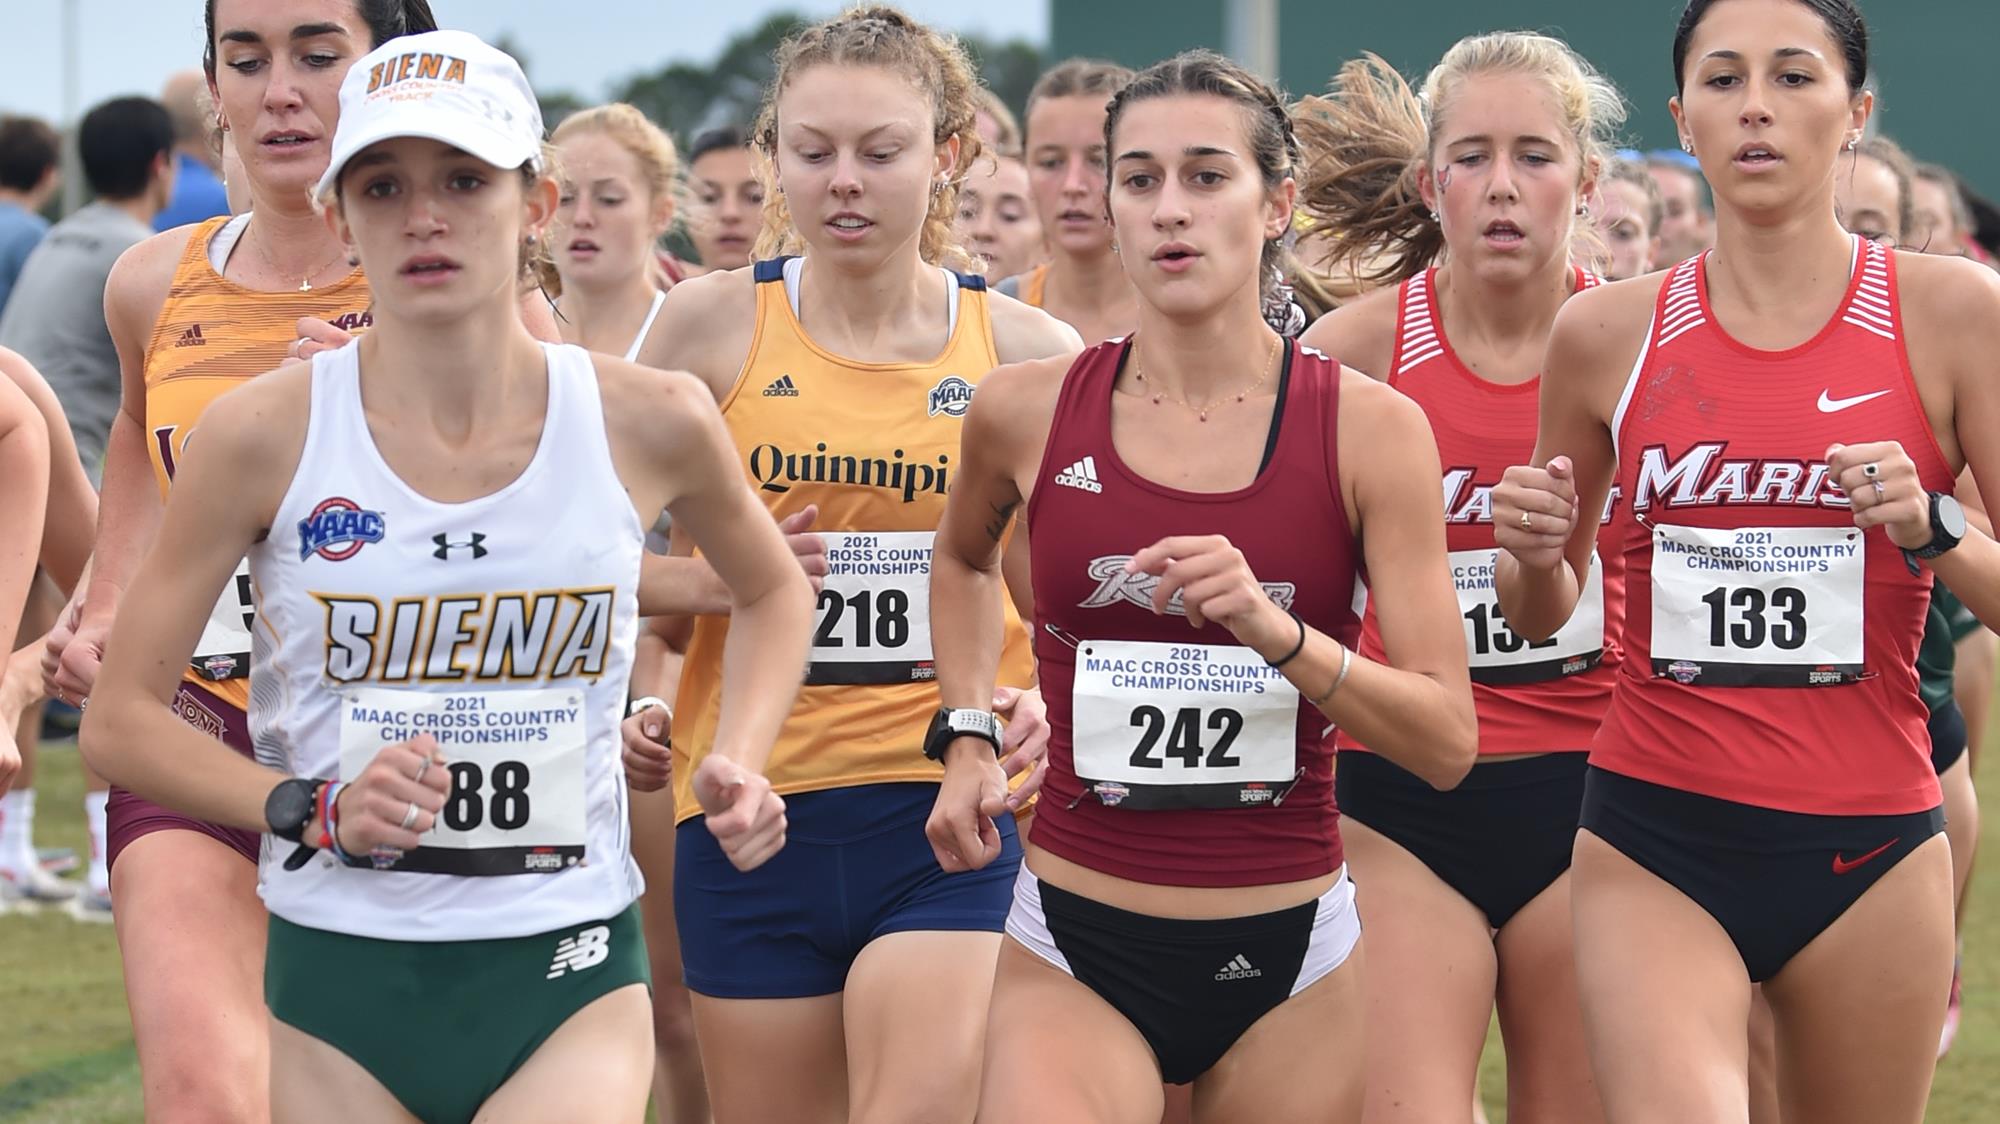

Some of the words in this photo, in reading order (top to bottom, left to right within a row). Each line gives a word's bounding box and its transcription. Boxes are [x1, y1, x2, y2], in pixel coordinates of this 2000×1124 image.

[366, 52, 467, 94] SIENA
[328, 311, 374, 331] MAA
[750, 442, 953, 503] Quinnipi
[1633, 441, 1852, 512] MARI
[1055, 473, 1103, 494] adidas
[298, 510, 385, 561] MAAC
[844, 537, 878, 548] 2021
[1735, 532, 1772, 544] 2021
[826, 549, 873, 562] ROSS
[877, 549, 933, 561] COUNT
[1662, 541, 1707, 555] MAAC
[1710, 546, 1767, 558] CROSS
[1771, 545, 1856, 558] COUNTRY
[829, 563, 929, 575] MPIONSHIPS
[1687, 556, 1829, 573] CHAMPIONSHIPS
[812, 589, 909, 648] 218
[1464, 602, 1558, 654] 13
[1702, 586, 1807, 650] 133
[308, 586, 616, 683] SIENA
[1171, 647, 1209, 661] 2021
[1086, 659, 1137, 673] MAAC
[1141, 661, 1202, 676] CROSS
[1207, 664, 1282, 680] COUNTR
[1809, 675, 1842, 684] SPORTS
[1111, 675, 1265, 694] CHAMPIONSHIPS
[445, 697, 486, 711] 2021
[176, 695, 223, 741] IONA
[352, 707, 407, 726] MAAC
[413, 713, 480, 728] CROSS
[486, 708, 578, 727] COUNTRY
[1129, 704, 1244, 768] 242
[433, 760, 530, 832] 88
[1214, 968, 1262, 981] adidas
